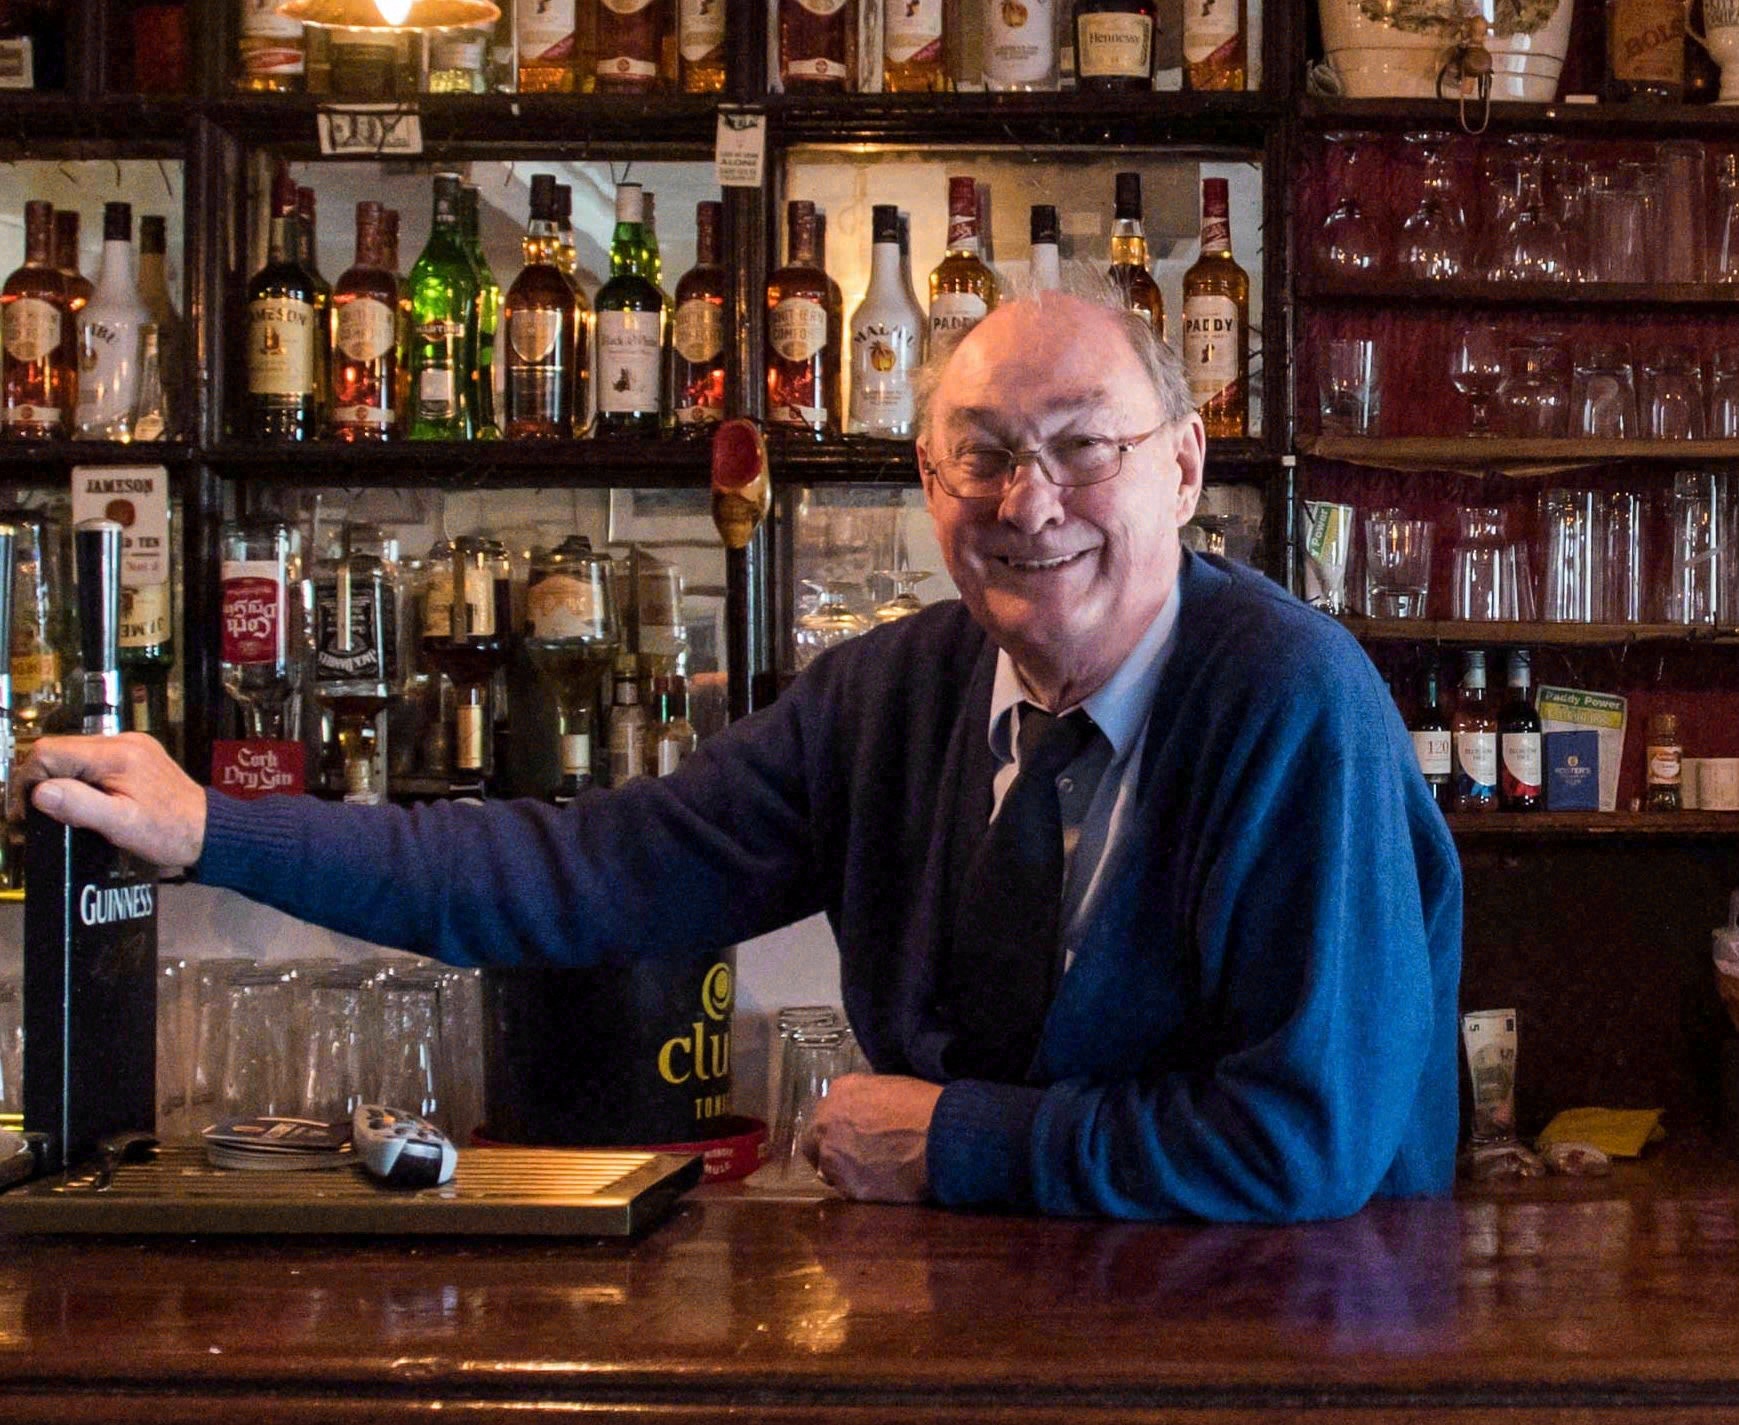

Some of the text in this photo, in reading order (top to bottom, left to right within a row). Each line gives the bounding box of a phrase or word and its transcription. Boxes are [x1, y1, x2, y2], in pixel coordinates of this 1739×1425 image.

[1089, 32, 1140, 45] Hennessy
[1186, 318, 1234, 332] PADDY
[86, 479, 154, 494] JAMESON
[1583, 695, 1622, 710] Power
[1427, 740, 1449, 754] 120
[237, 747, 278, 767] Cork
[223, 764, 293, 790] Dry Gin
[80, 883, 153, 925] GUINNESS
[658, 1021, 731, 1084] clu
[696, 1095, 729, 1120] TON
